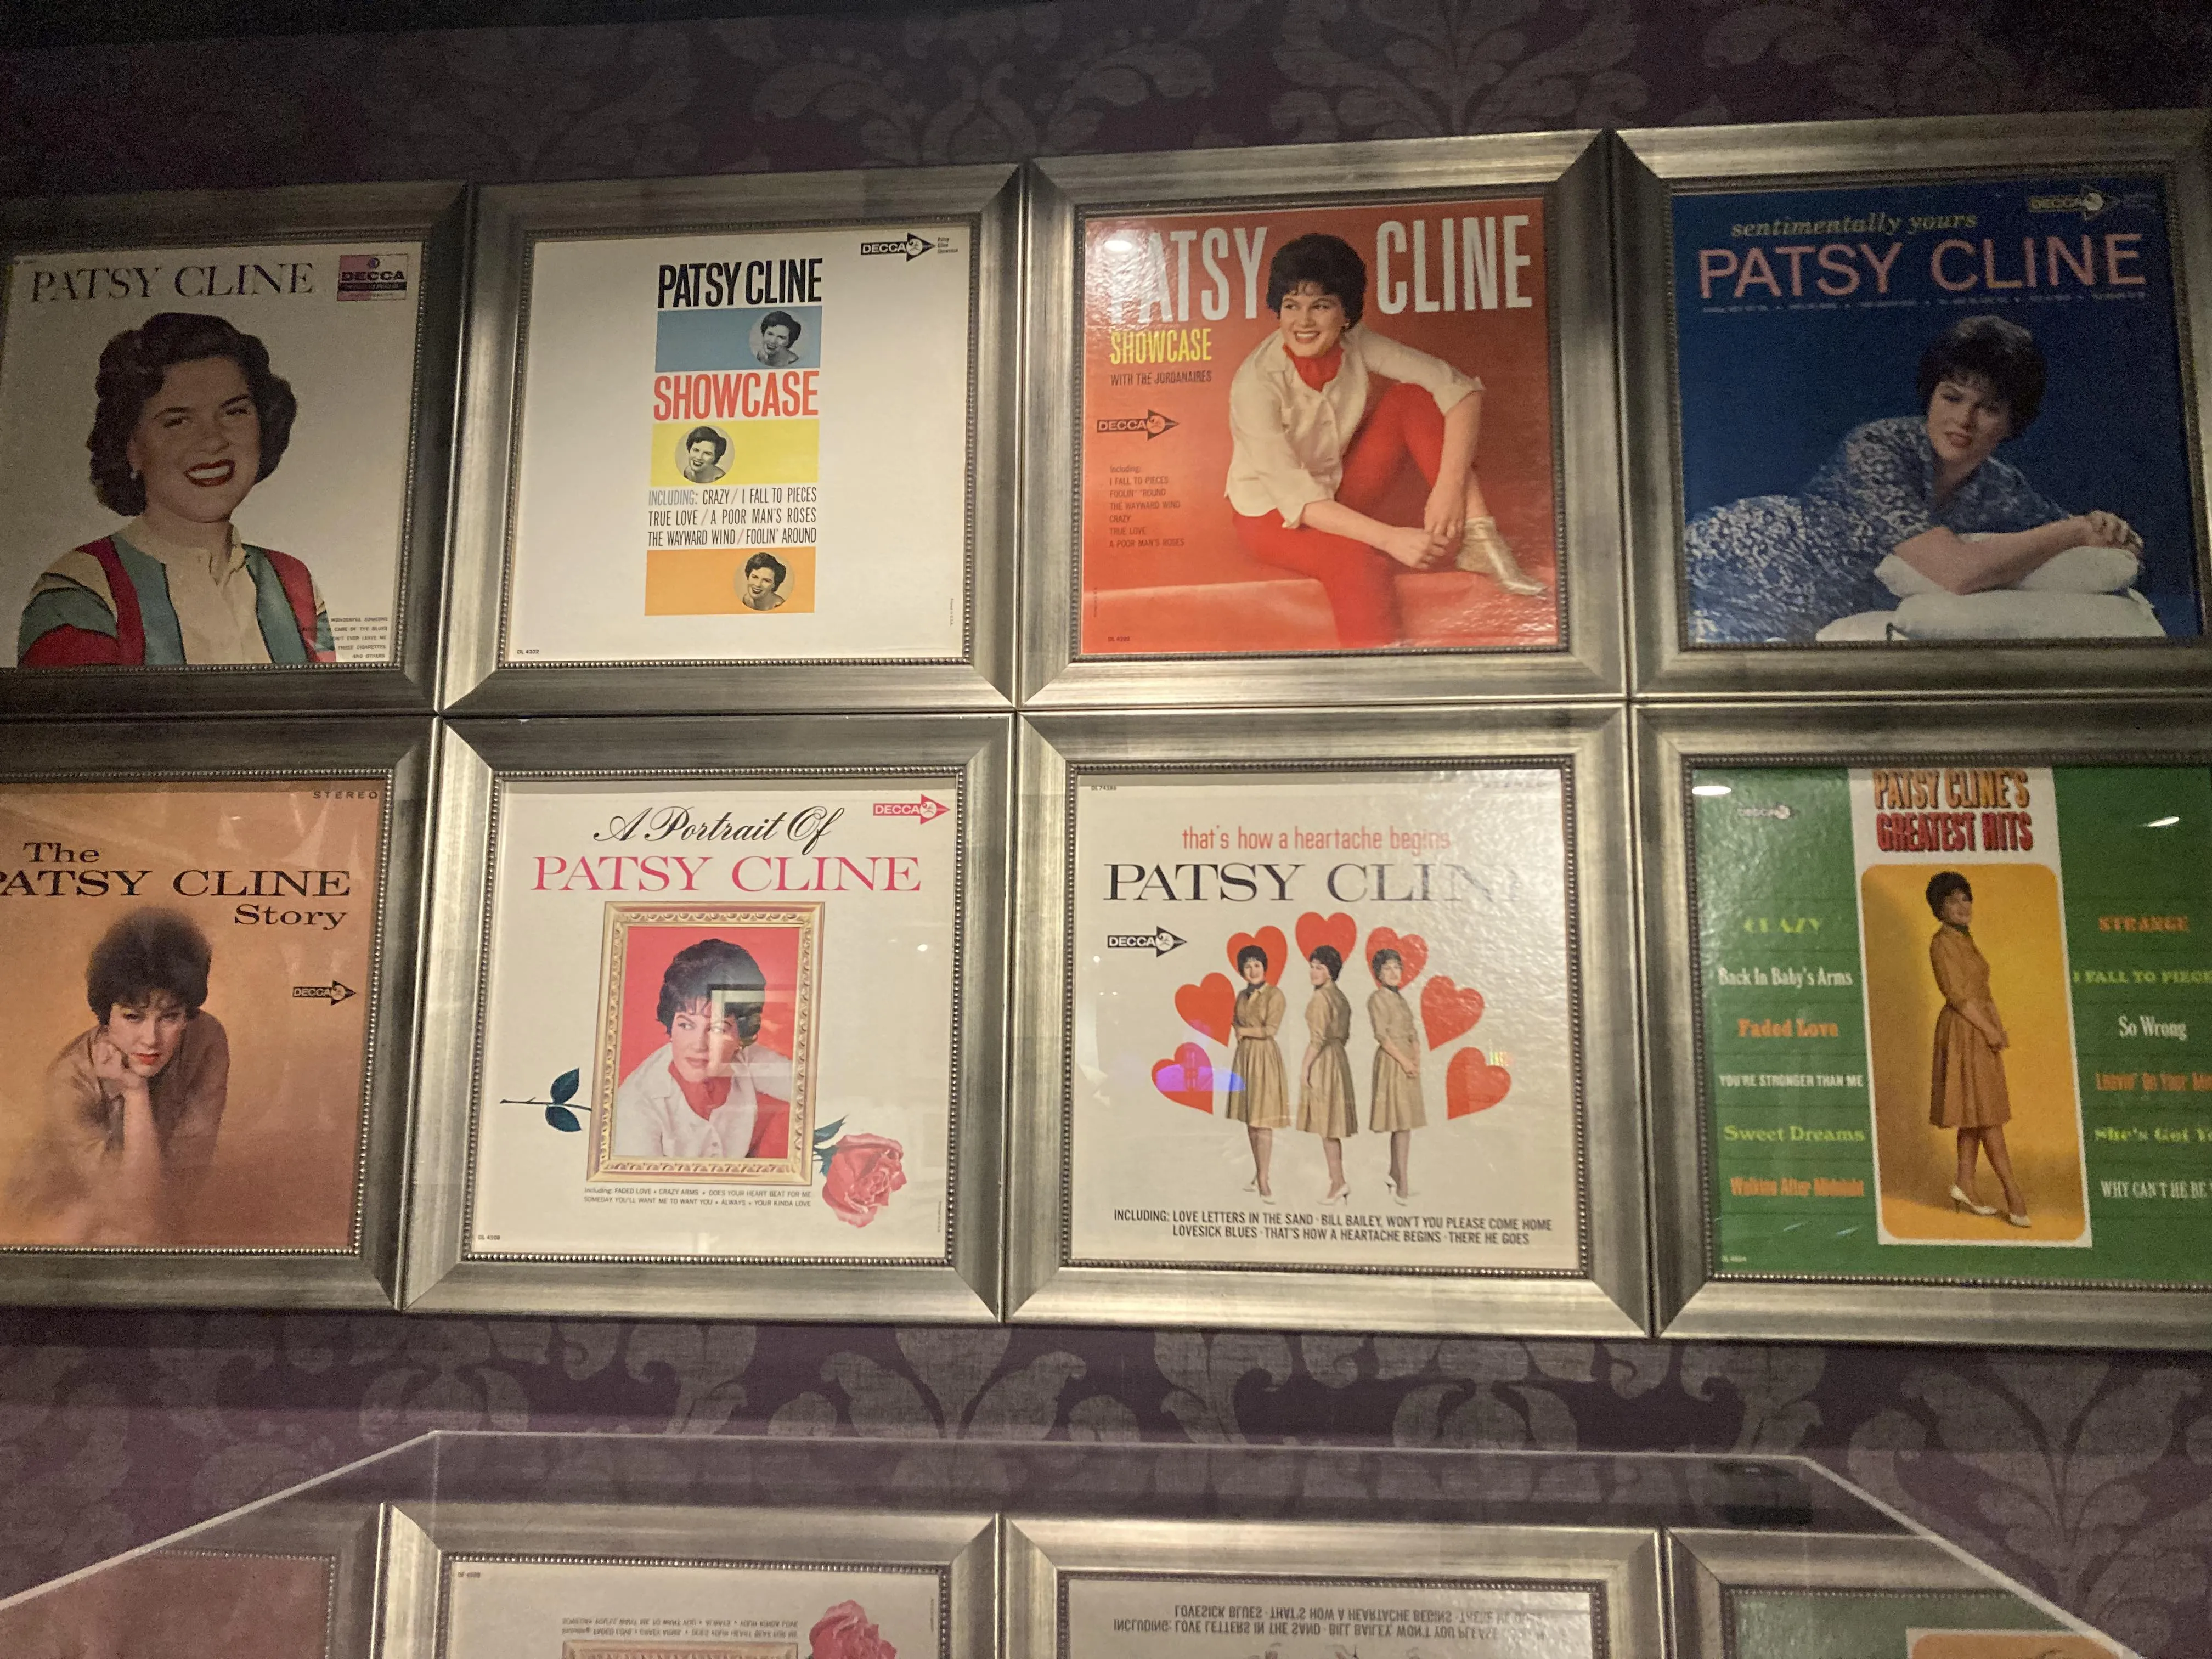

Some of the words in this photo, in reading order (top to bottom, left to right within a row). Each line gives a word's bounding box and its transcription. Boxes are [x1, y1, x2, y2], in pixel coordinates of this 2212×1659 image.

[1731, 212, 1900, 238] sentimentally
[1908, 215, 1977, 235] yours
[862, 242, 906, 253] DECCA
[1376, 215, 1532, 315] CLINE
[1699, 242, 1904, 299] PATSY
[1931, 233, 2146, 292] CLINE
[32, 267, 160, 302] PATSY
[174, 263, 313, 297] CLINE
[341, 270, 405, 281] DECCA
[658, 262, 742, 308] PATSY
[746, 258, 823, 305] CLINE
[1110, 328, 1212, 365] SHOWCASE
[1111, 373, 1133, 386] WITH
[1136, 372, 1152, 385] THE
[1154, 370, 1212, 385] JORDANAIRES
[653, 370, 820, 421] SHOWCASE
[1098, 420, 1147, 431] DECCA
[1146, 476, 1169, 484] PIECES
[648, 489, 698, 505] INCLUDING:
[703, 489, 730, 505] CRAZY
[750, 488, 769, 504] FALL
[771, 488, 782, 503] TO
[788, 487, 816, 503] PIECES
[1110, 502, 1122, 510] THE
[648, 511, 672, 527] TRUE
[676, 510, 698, 526] LOVE
[710, 510, 717, 525] A
[723, 509, 746, 524] POOR
[752, 507, 781, 524] MAN'S
[788, 507, 816, 523] ROSES
[1109, 515, 1131, 523] CRAZY
[648, 531, 663, 546] THE
[667, 530, 707, 546] WAYWARD
[712, 529, 735, 545] WIND
[746, 528, 778, 544] FOOLIN'
[782, 527, 816, 544] AROUND
[1110, 527, 1126, 535] TRUE
[1130, 527, 1146, 535] LOVE
[1163, 538, 1185, 546] ROSES
[313, 791, 378, 799] STEREO
[1872, 769, 1940, 809] PATSY
[1944, 768, 2030, 809] CLINE'S
[875, 805, 920, 815] DECCA
[593, 807, 653, 842] A
[644, 806, 788, 842] Portrait
[787, 805, 845, 856] Of
[1876, 812, 1977, 851] GREATEST
[1981, 811, 2033, 851] HITS
[1182, 825, 1229, 850] that's
[1238, 826, 1273, 849] how
[1279, 832, 1288, 849] a
[1294, 826, 1383, 850] heartache
[1390, 826, 1451, 857] begins
[22, 842, 100, 863] The
[173, 870, 350, 897] CLINE
[531, 856, 713, 891] PATSY
[732, 856, 922, 893] CLINE
[1103, 863, 1306, 902] PATSY
[1327, 863, 1522, 902] CLIN
[235, 904, 348, 930] Story
[2098, 916, 2190, 932] STRANGE
[1109, 936, 1156, 947] DECCA
[1718, 966, 1752, 986] Back
[1754, 966, 1768, 985] In
[1771, 966, 1815, 989] Baby's
[1817, 966, 1853, 986] Arms
[2085, 970, 2129, 984] FALL
[2131, 970, 2156, 984] TO
[294, 988, 330, 997] DECCA
[1738, 1018, 1792, 1037] Faded
[1796, 1018, 1838, 1038] Love
[2118, 1015, 2138, 1037] So
[2140, 1015, 2187, 1041] Wrong
[1719, 1075, 1757, 1087] YOU'RE
[1759, 1074, 1814, 1087] STRONGER
[1816, 1074, 1844, 1087] THAN
[1847, 1075, 1863, 1087] ME
[1723, 1125, 1784, 1141] Sweet
[1789, 1125, 1865, 1142] Dreams
[2101, 1180, 2129, 1198] WHY
[2132, 1180, 2167, 1199] CAN'T
[2170, 1181, 2188, 1199] HE
[2190, 1181, 2208, 1199] BE
[1114, 1209, 1170, 1222] INCLUDING:
[1173, 1210, 1198, 1222] LOVE
[1201, 1211, 1245, 1223] LETTERS
[1249, 1211, 1260, 1224] IN
[1263, 1212, 1282, 1224] THE
[1285, 1213, 1313, 1225] SAND
[1321, 1214, 1342, 1226] BILL
[1386, 1216, 1420, 1228] WON'T
[1422, 1216, 1443, 1228] YOU
[1447, 1217, 1486, 1229] PLEASE
[1488, 1218, 1519, 1230] COME
[1522, 1219, 1552, 1231] HOME
[1173, 1224, 1222, 1237] LOVESICK
[1225, 1226, 1258, 1238] BLUES
[1263, 1227, 1300, 1239] THAT'S
[1303, 1228, 1328, 1240] HOW
[1330, 1229, 1337, 1240] A
[1341, 1229, 1401, 1242] HEARTACHE
[1404, 1231, 1441, 1243] BEGINS
[1449, 1232, 1482, 1244] THERE
[1484, 1232, 1498, 1244] HE
[1502, 1233, 1530, 1245] GOES
